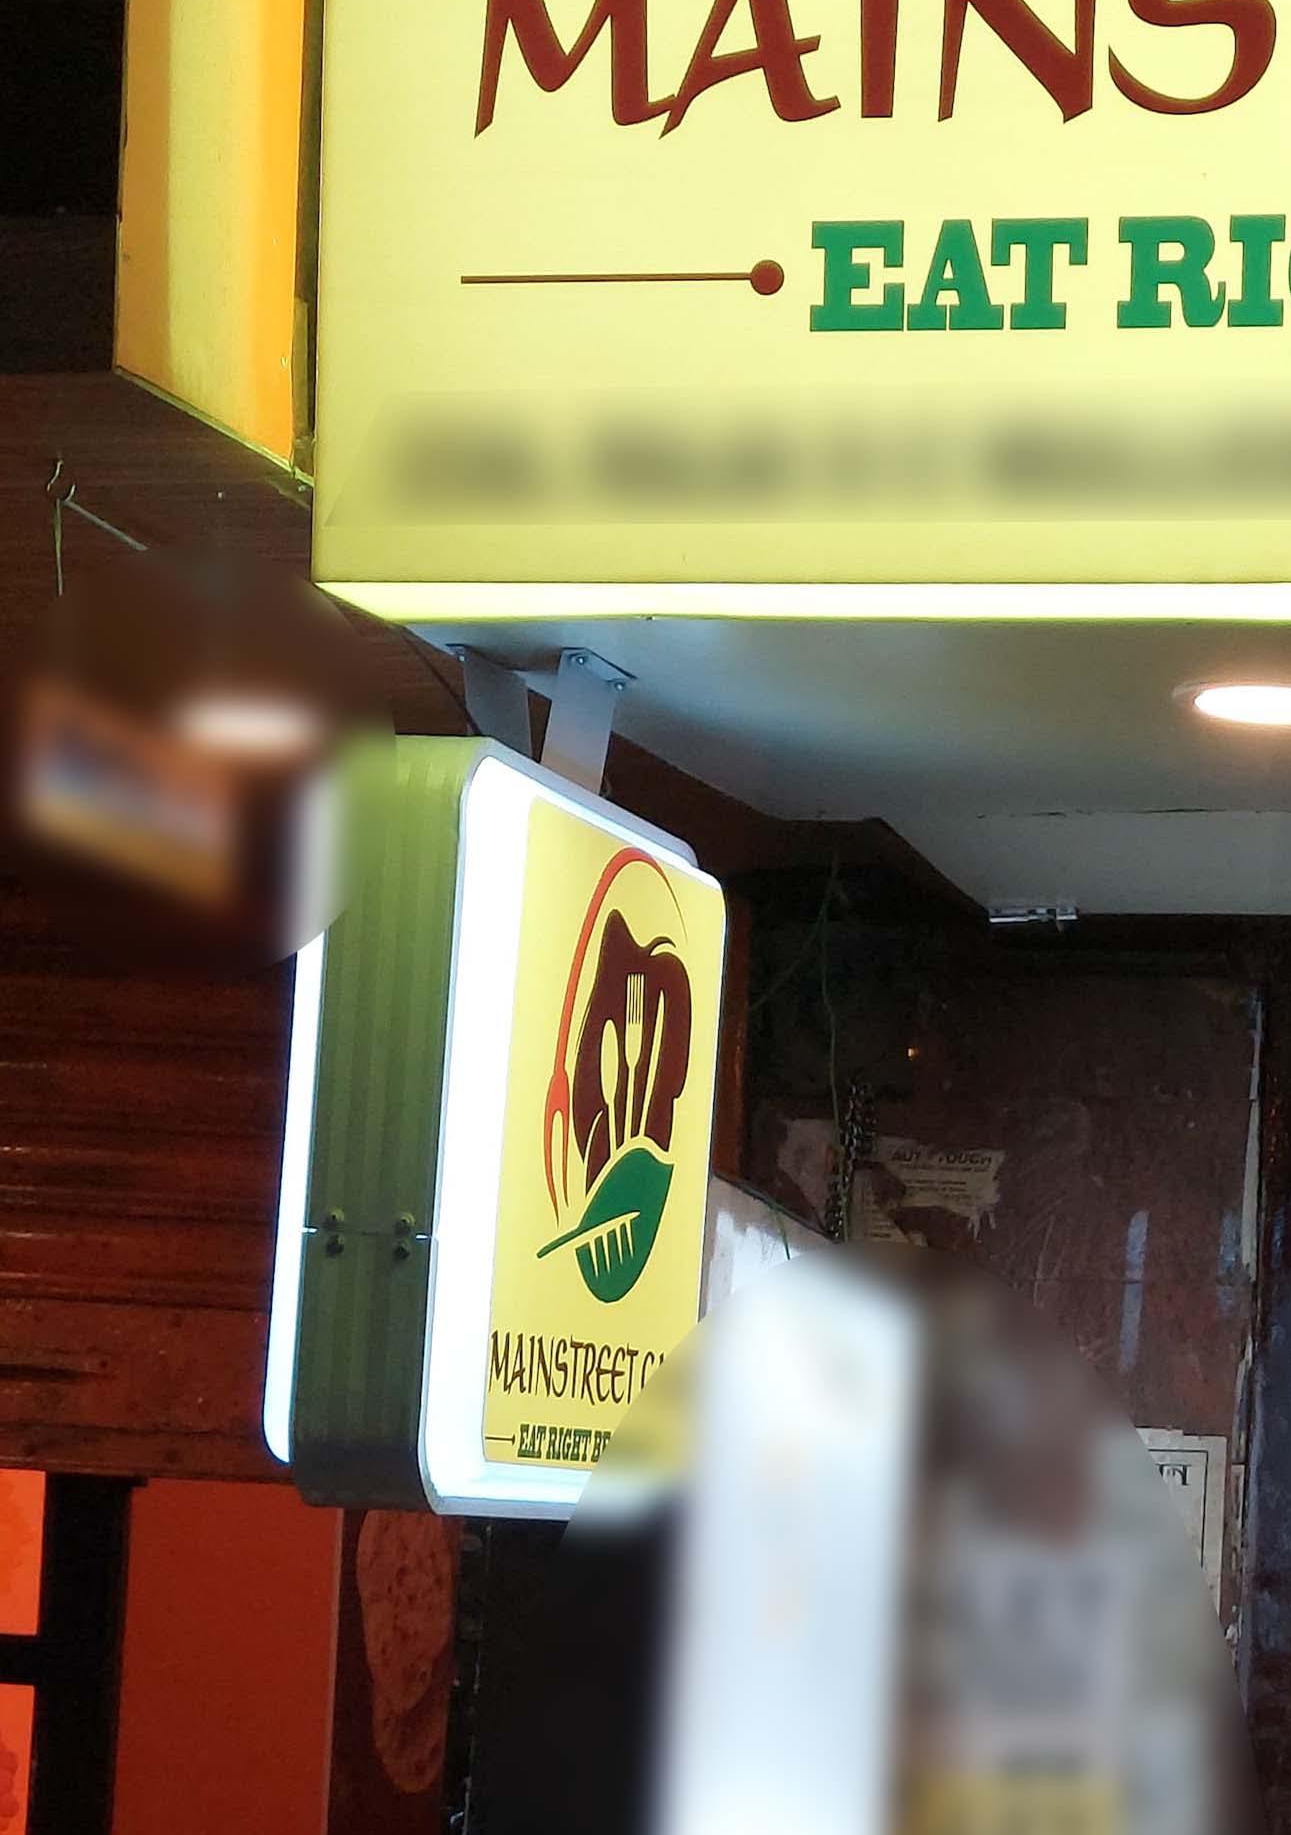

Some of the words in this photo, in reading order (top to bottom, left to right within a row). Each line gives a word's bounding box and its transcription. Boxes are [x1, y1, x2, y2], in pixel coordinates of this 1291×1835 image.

[809, 219, 1089, 332] EAT
[489, 1330, 638, 1405] MAINSTREET
[517, 1423, 547, 1458] EAT
[546, 1426, 592, 1462] RIGHT
